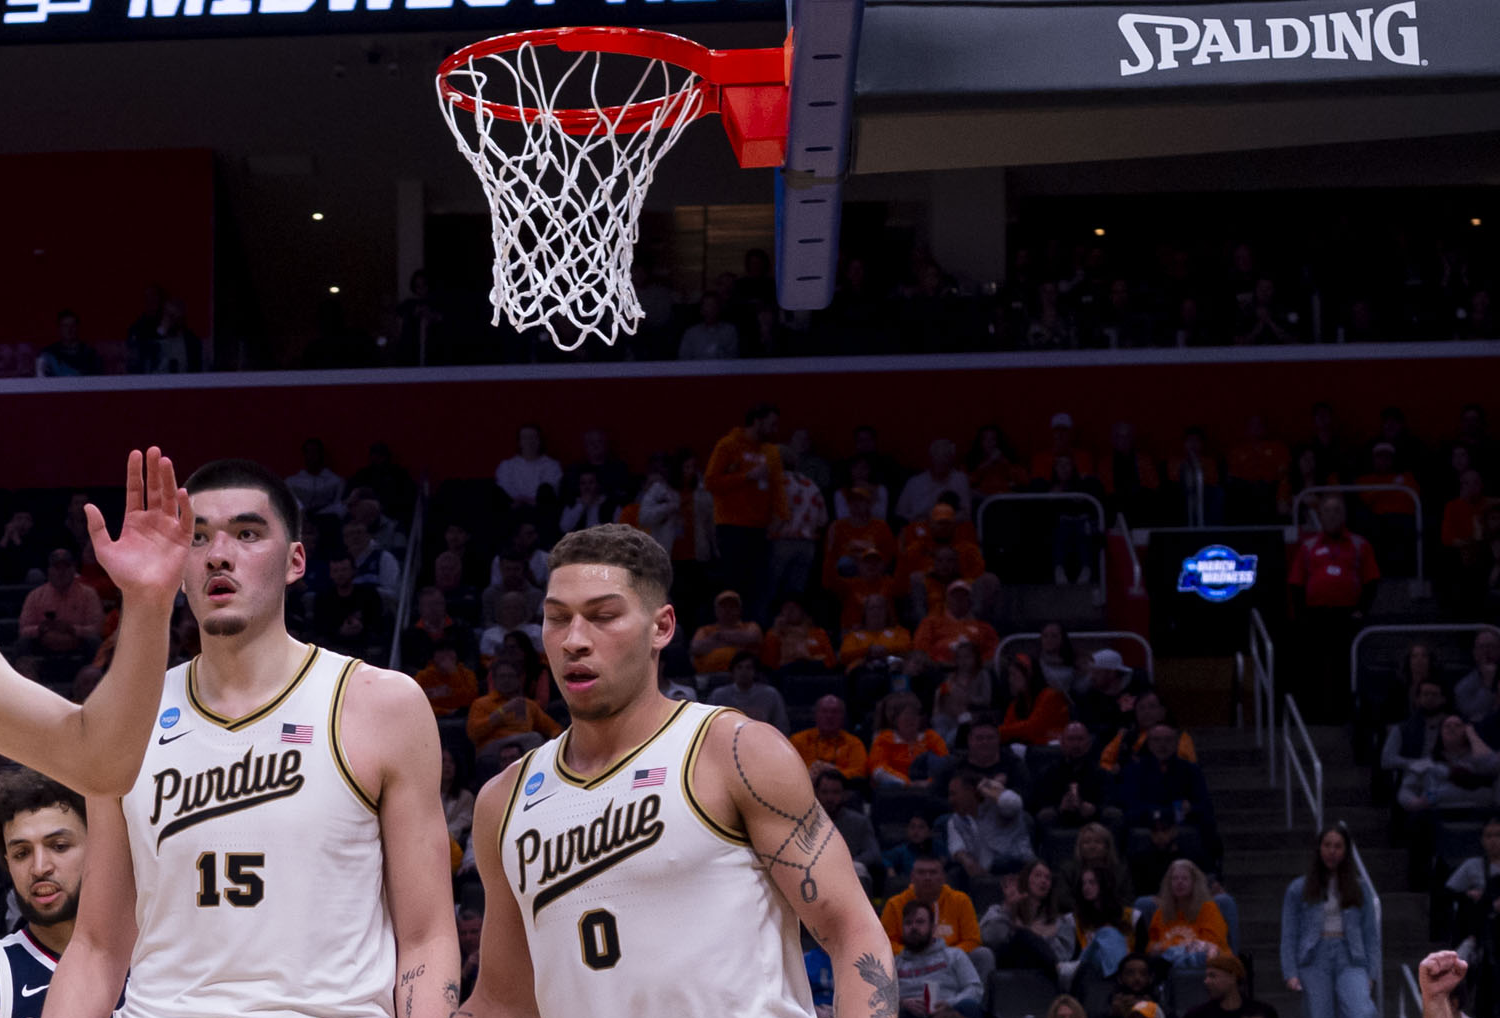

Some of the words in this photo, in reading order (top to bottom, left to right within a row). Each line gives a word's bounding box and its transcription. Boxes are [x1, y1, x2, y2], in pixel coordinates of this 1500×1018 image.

[1118, 1, 1422, 76] SPALDING
[150, 746, 306, 840] Purdue
[196, 851, 265, 908] 15
[515, 797, 664, 908] Purdue
[578, 908, 621, 971] 0
